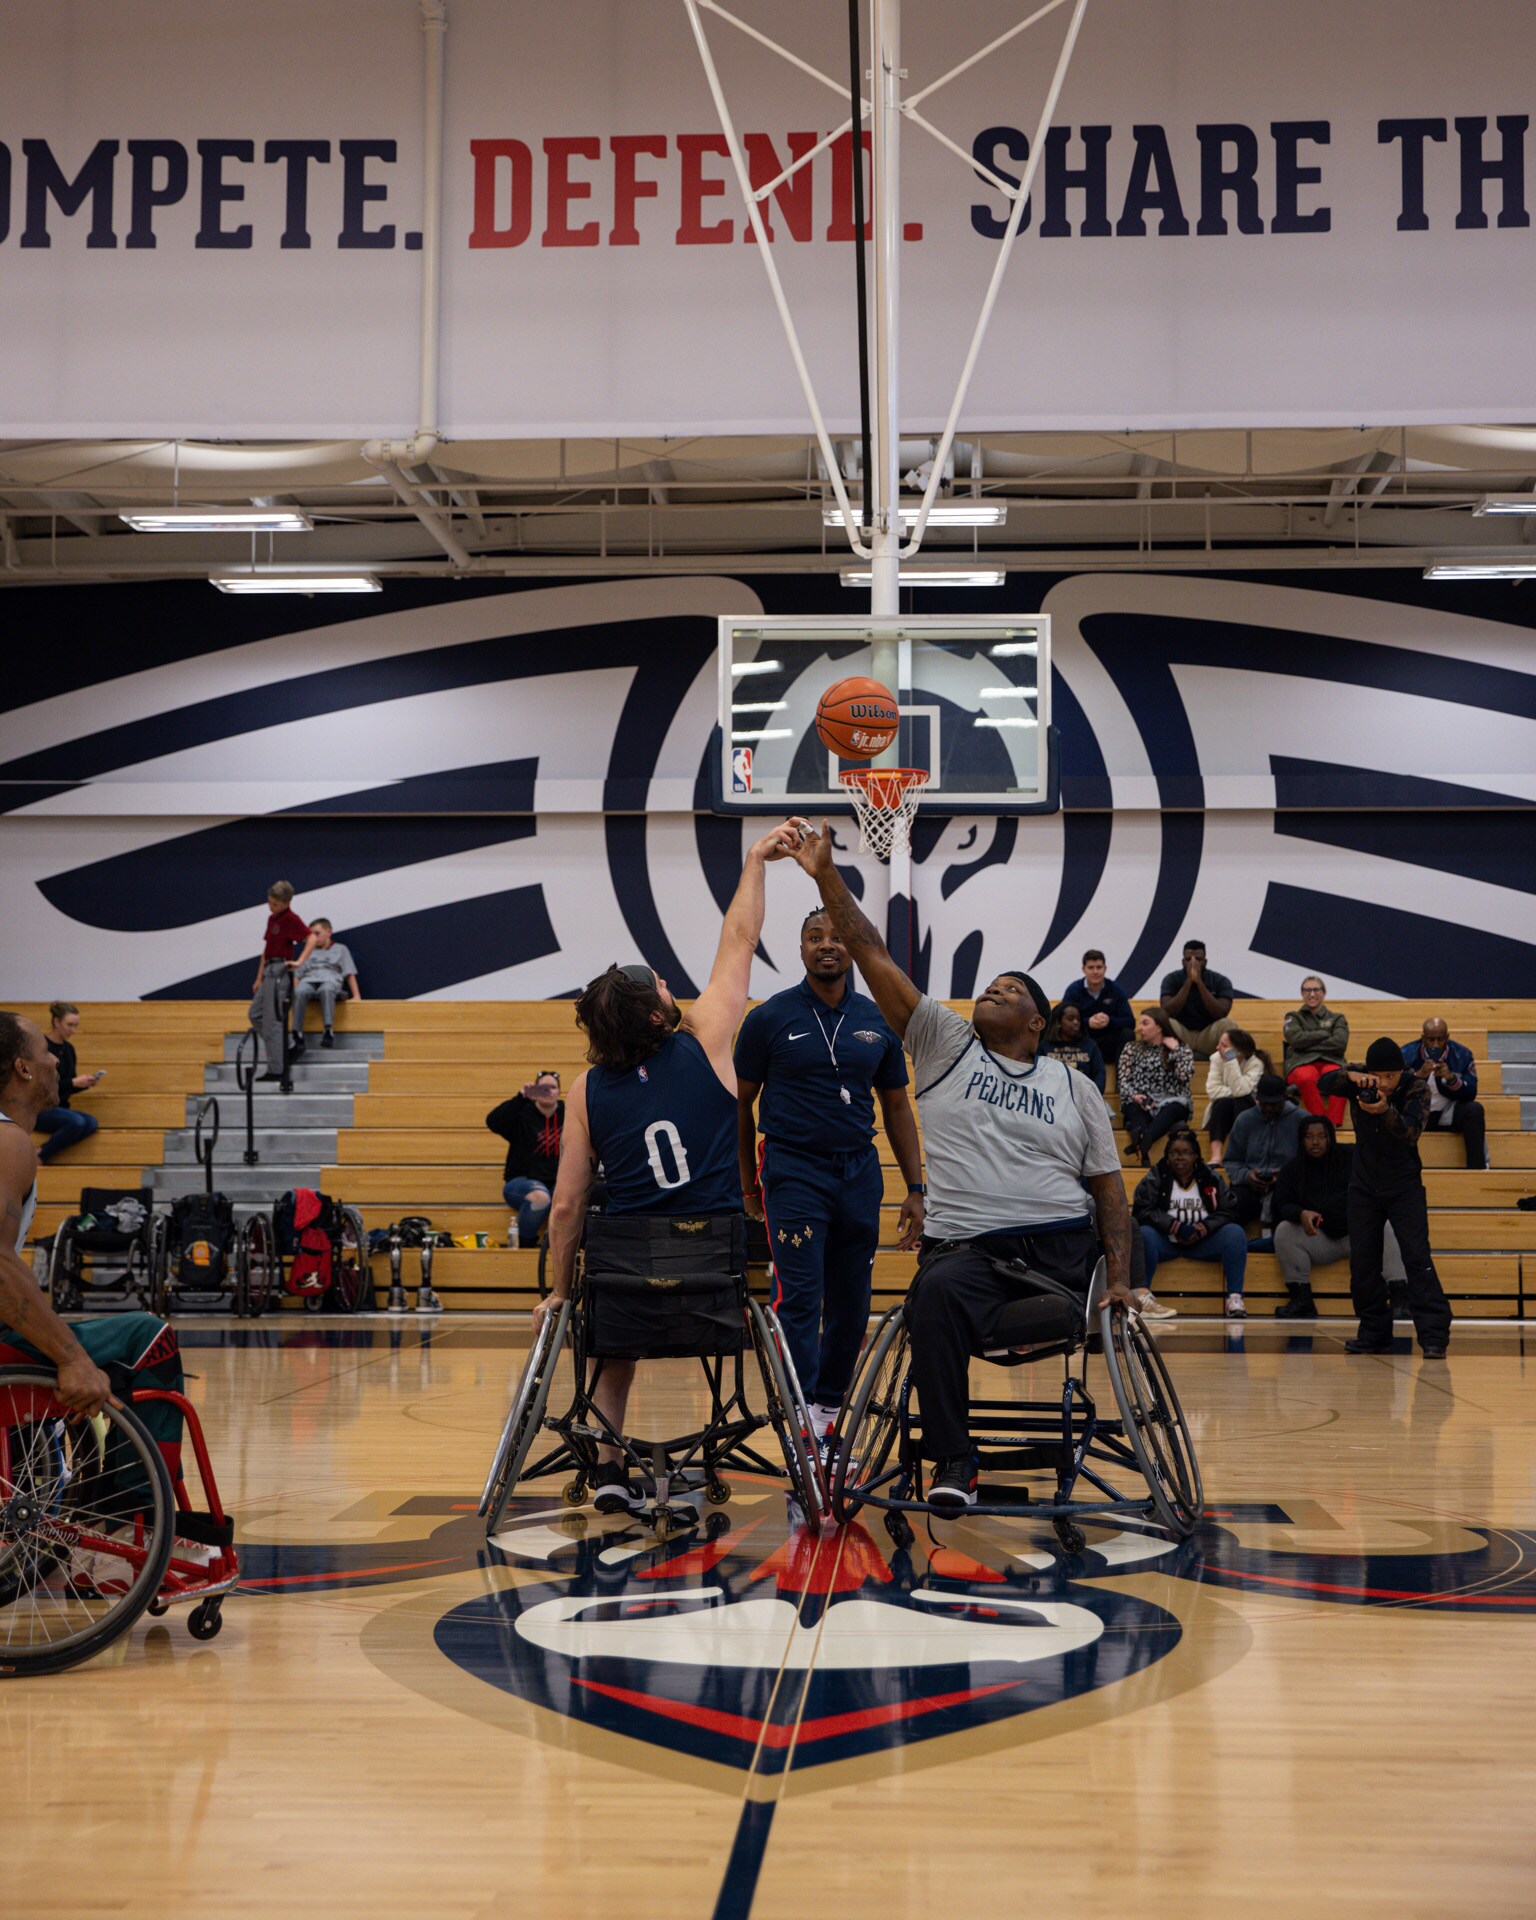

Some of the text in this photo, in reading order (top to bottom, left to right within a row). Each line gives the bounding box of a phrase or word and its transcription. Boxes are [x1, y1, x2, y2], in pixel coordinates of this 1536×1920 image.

[0, 138, 423, 251] MPETE.
[970, 119, 1331, 240] SHARE
[1377, 114, 1530, 231] TH
[850, 703, 897, 720] Wilson
[964, 1071, 1055, 1125] PELICANS
[644, 1120, 691, 1189] 0
